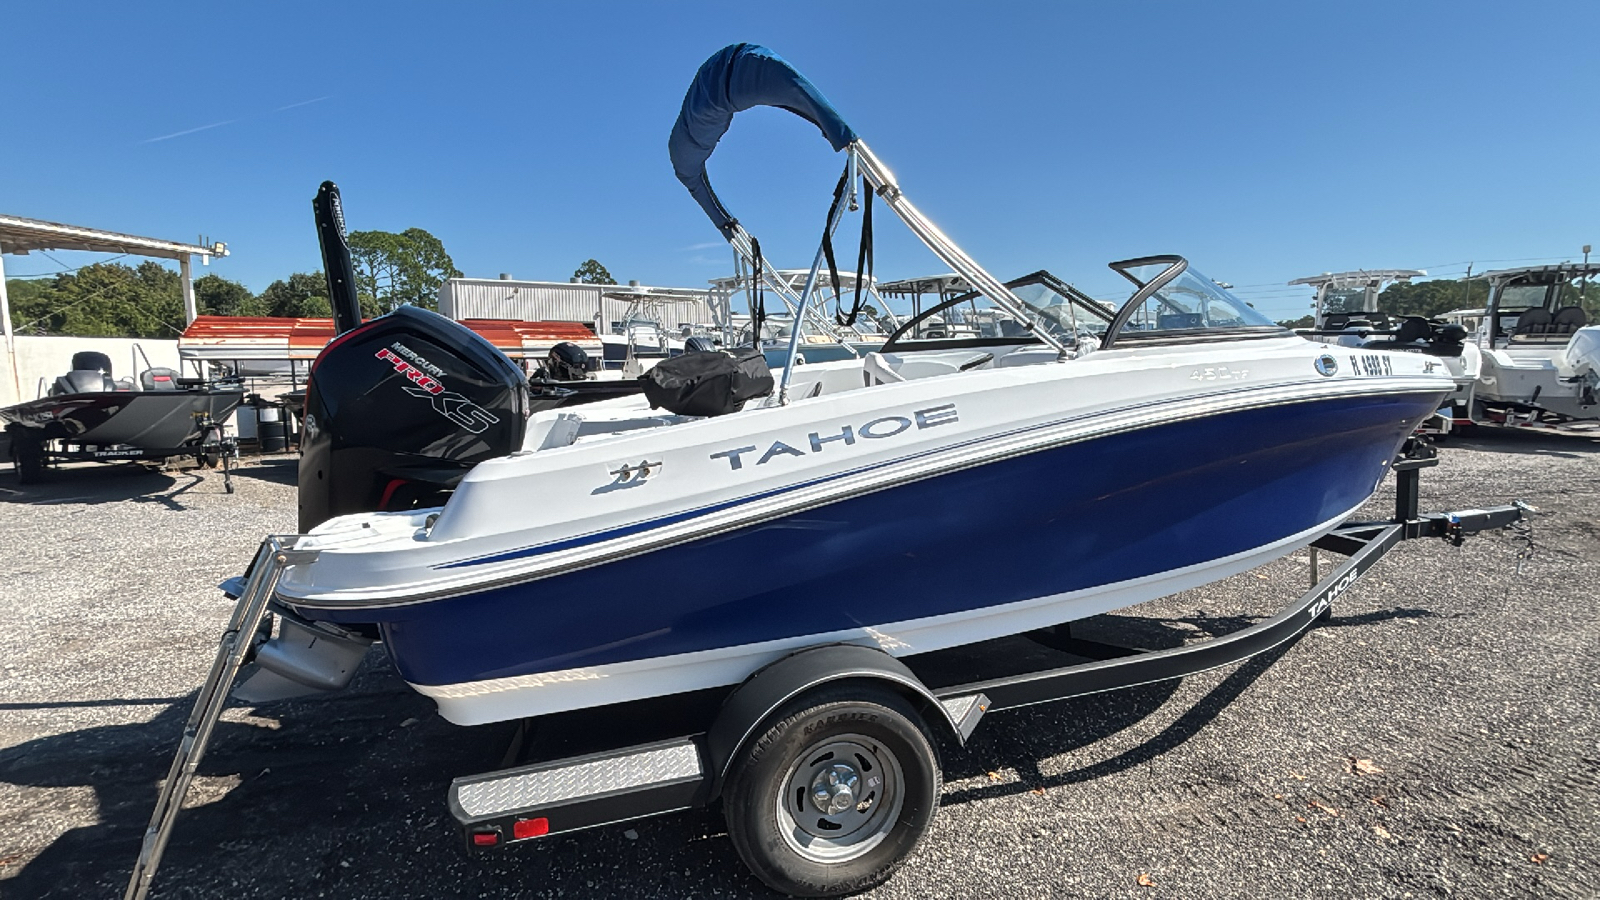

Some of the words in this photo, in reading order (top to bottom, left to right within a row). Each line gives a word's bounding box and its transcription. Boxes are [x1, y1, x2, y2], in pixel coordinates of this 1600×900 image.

[375, 348, 445, 395] PRO
[391, 341, 447, 377] MERCURY
[401, 386, 500, 434] XS
[710, 403, 959, 470] TAHOE
[1308, 568, 1357, 617] TAHOE
